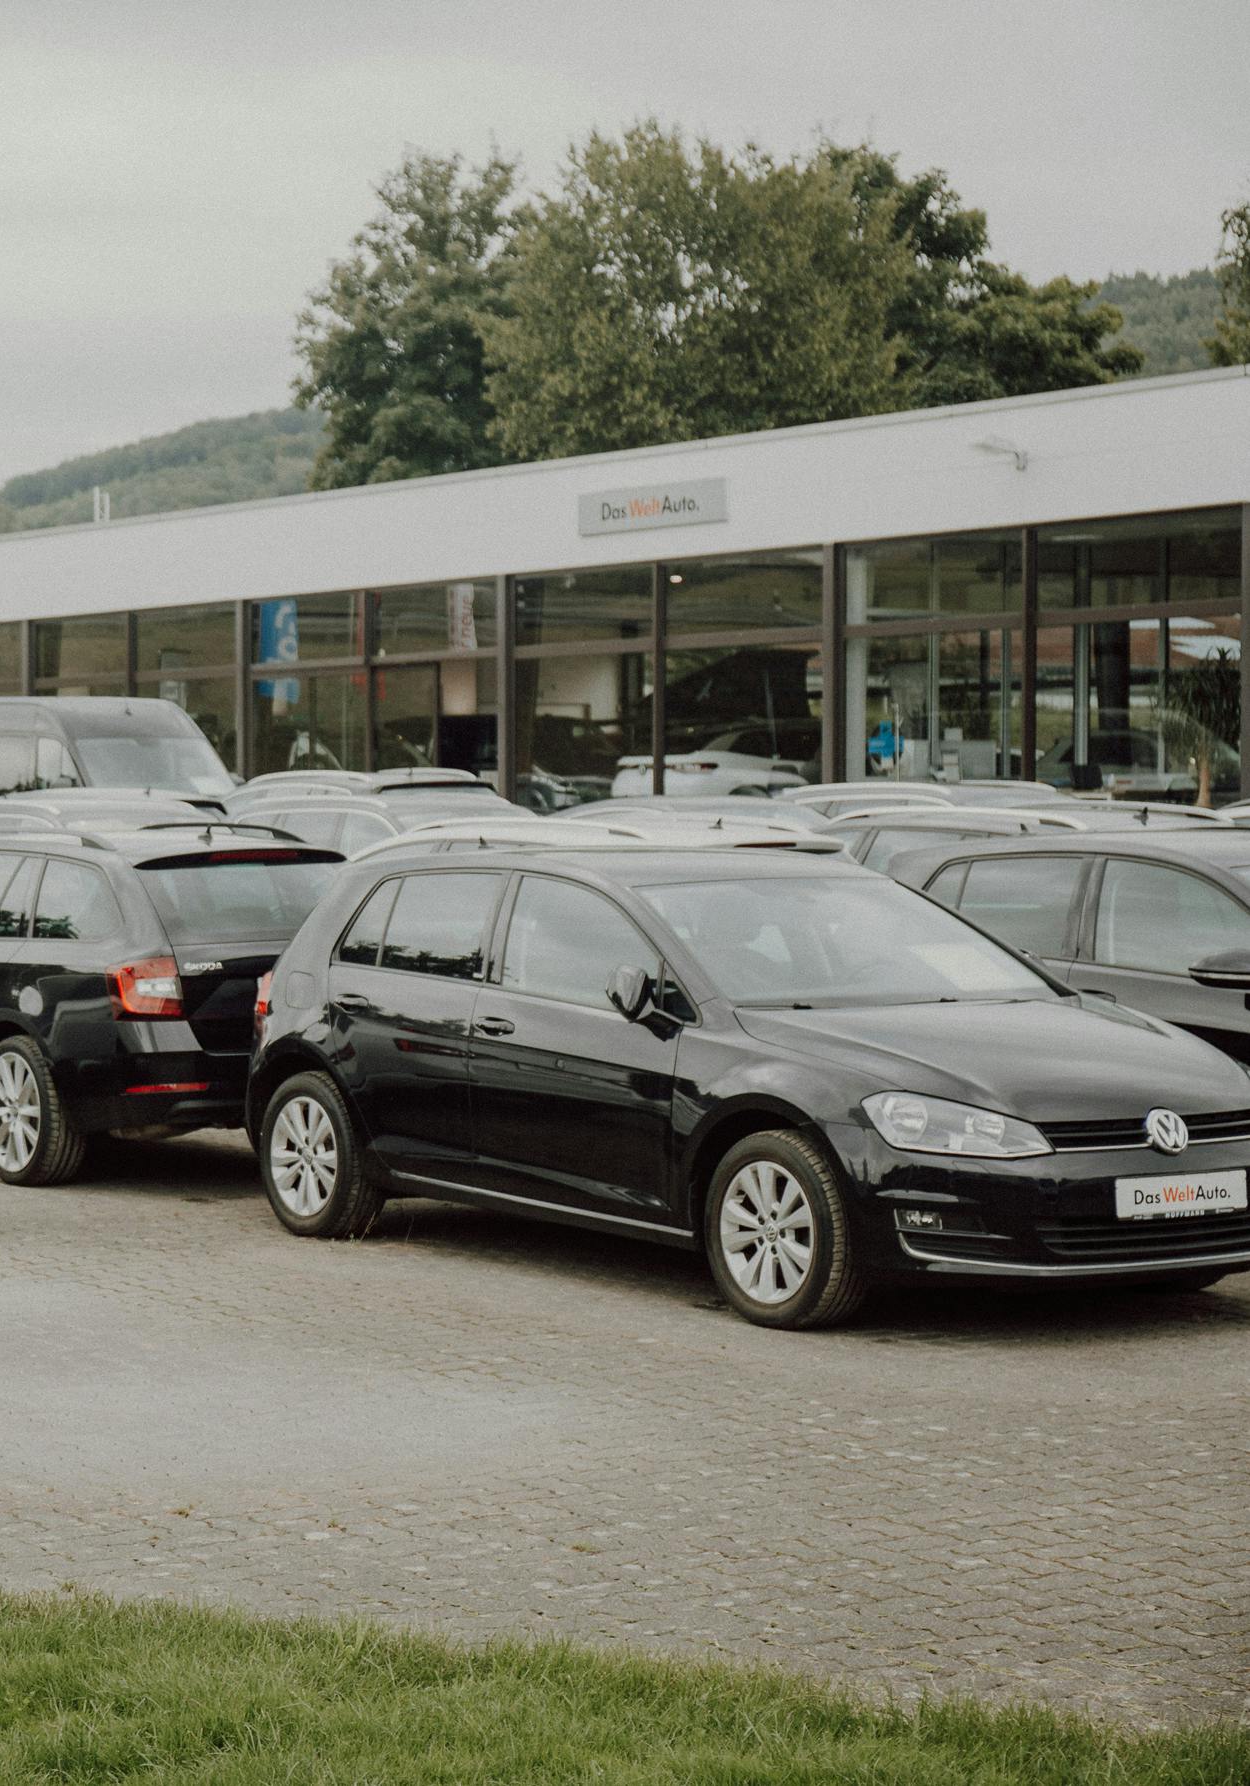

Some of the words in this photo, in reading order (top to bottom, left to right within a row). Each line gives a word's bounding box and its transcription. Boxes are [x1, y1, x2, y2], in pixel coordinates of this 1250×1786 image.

[601, 502, 627, 521] Das
[628, 494, 700, 518] WeltAuto.
[1134, 1189, 1161, 1205] Das
[1162, 1184, 1231, 1203] WeltAuto.
